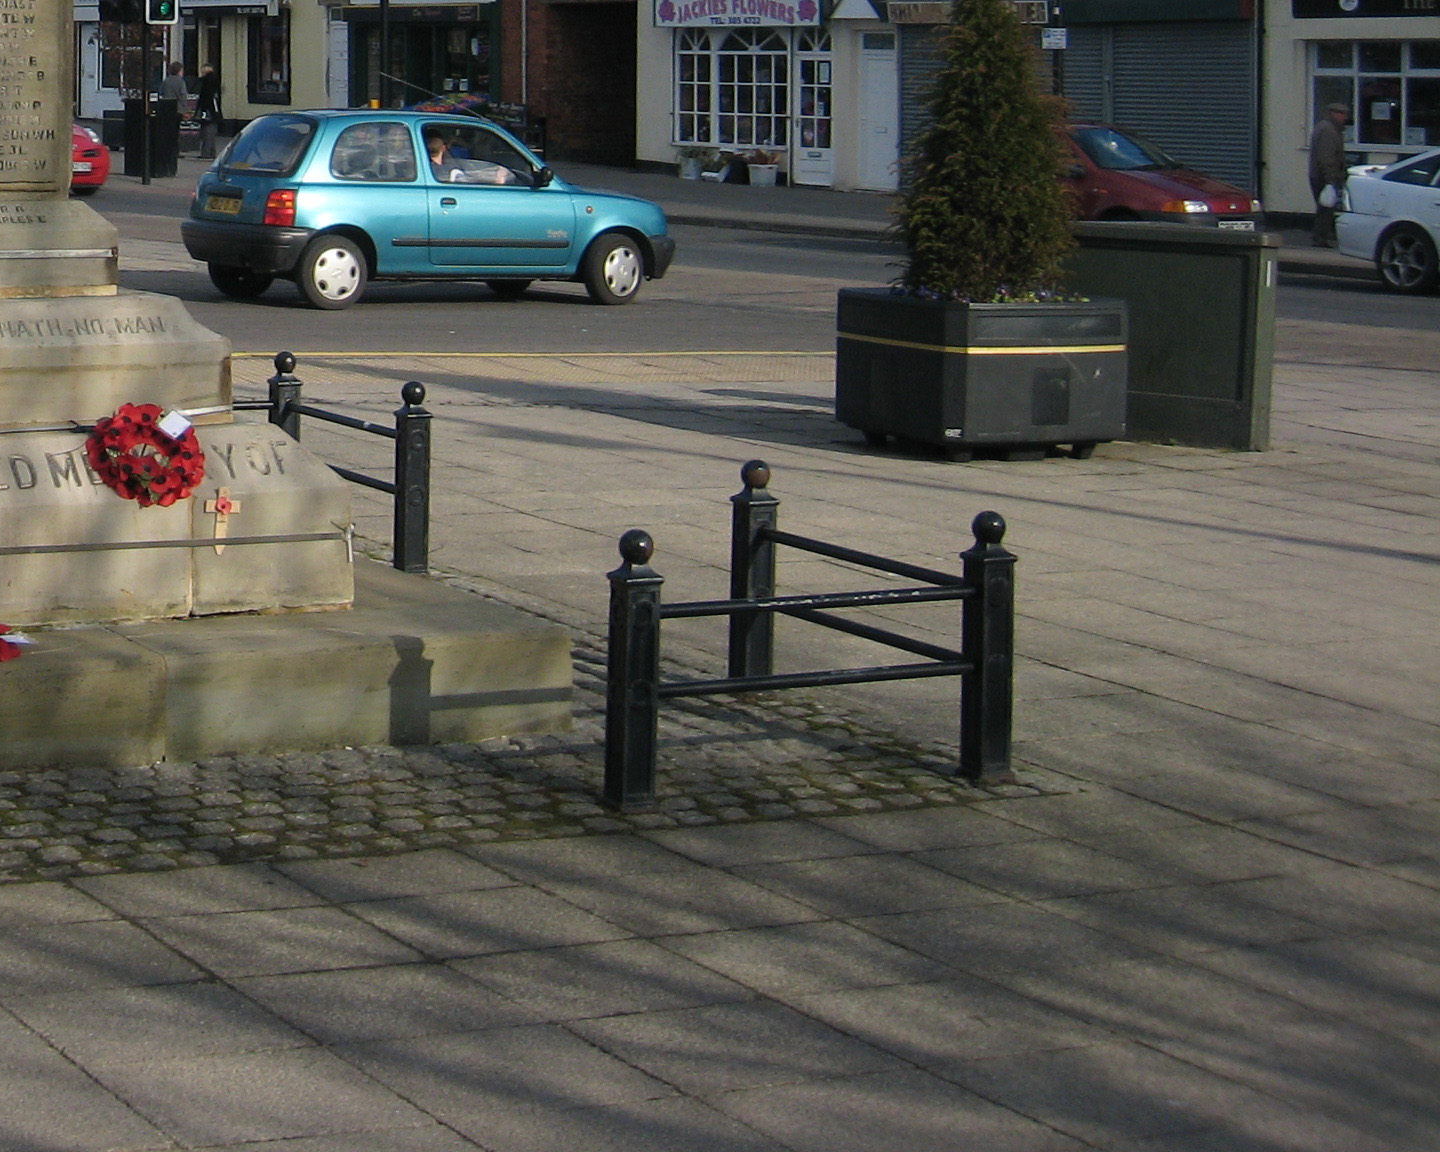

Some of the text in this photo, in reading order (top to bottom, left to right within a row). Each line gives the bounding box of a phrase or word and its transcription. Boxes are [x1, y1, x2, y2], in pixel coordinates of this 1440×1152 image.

[743, 16, 761, 24] 4722
[73, 316, 106, 336] NO
[115, 315, 167, 334] MAN
[245, 439, 288, 476] OF
